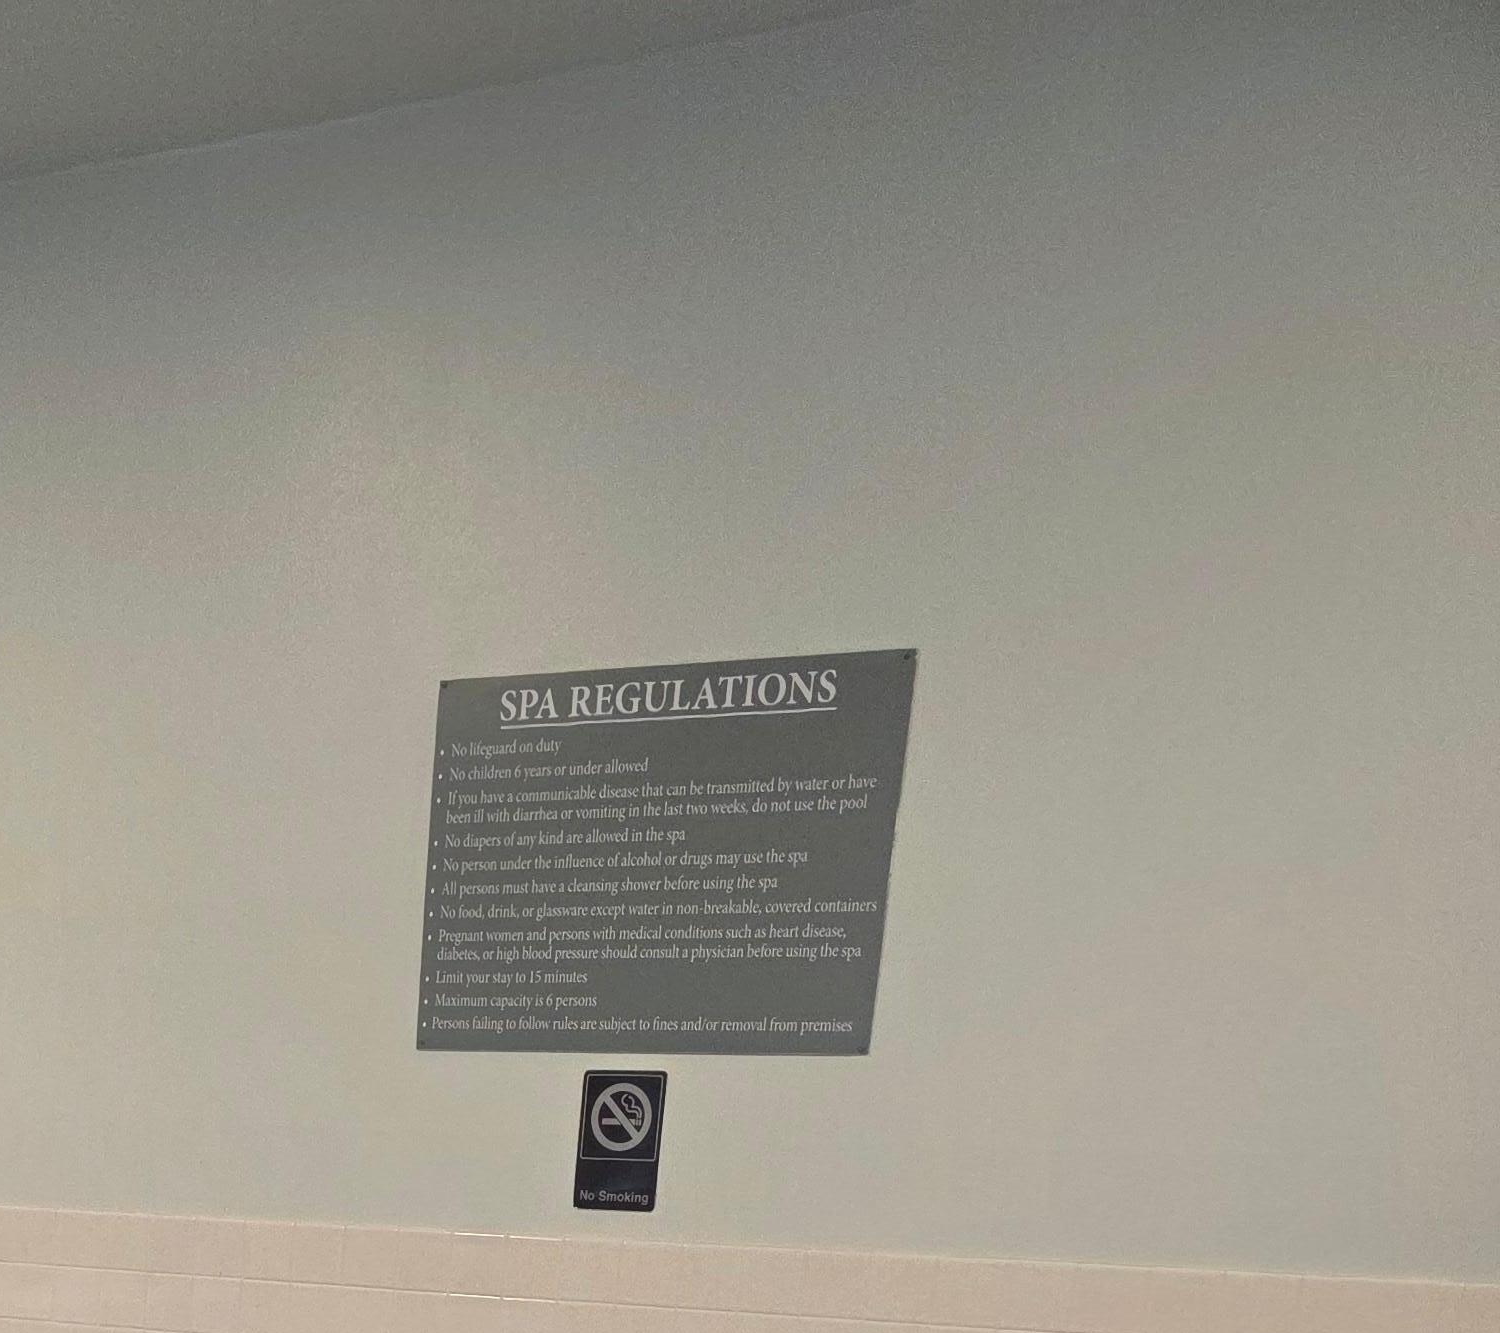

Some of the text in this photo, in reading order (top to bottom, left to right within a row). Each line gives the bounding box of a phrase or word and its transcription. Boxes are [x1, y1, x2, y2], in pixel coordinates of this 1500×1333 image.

[499, 668, 838, 722] SPA REGULATIONS
[451, 737, 562, 760] No lifeguard on duty
[449, 756, 649, 782] No children 6 years or under allowed
[448, 773, 877, 809] If you have a communicable disease that can be transmitted by water or have
[446, 809, 471, 825] been
[473, 808, 485, 823] ill
[487, 807, 510, 823] with
[512, 806, 558, 822] diarrhea
[560, 809, 574, 820] or
[575, 804, 626, 823] vomiting
[628, 803, 640, 818] in
[643, 801, 662, 817] the
[663, 800, 683, 817] last
[686, 803, 708, 815] two
[751, 797, 768, 813] do
[770, 799, 791, 812] not
[794, 800, 815, 812] use
[817, 795, 837, 811] the
[838, 793, 868, 815] pool
[444, 826, 686, 852] No diapers of any kind are allowed in the spa
[443, 848, 808, 876] No person under the influence of alcohol or drugs may use the spa
[442, 873, 778, 900] All persons must have a cleansing shower before using the spa
[440, 904, 456, 919] No
[522, 907, 535, 918] or
[535, 902, 589, 922] glassware
[590, 903, 626, 921] except
[628, 903, 660, 916] water
[661, 901, 673, 915] in
[765, 897, 812, 914] covered
[814, 897, 878, 913] containers
[438, 928, 484, 947] Pregnant
[486, 931, 524, 942] women
[526, 926, 547, 941] and
[548, 930, 591, 945] persons
[592, 925, 616, 941] with
[618, 924, 663, 940] medical
[664, 924, 724, 940] conditions
[725, 923, 752, 939] such
[754, 927, 767, 939] as
[768, 923, 799, 939] heart
[482, 950, 495, 961] or
[496, 945, 520, 965] high
[521, 945, 553, 960] blood
[554, 948, 599, 964] pressure
[600, 944, 638, 959] should
[639, 943, 680, 959] consult
[681, 948, 689, 959] a
[690, 943, 744, 964] physician
[746, 943, 784, 958] before
[785, 943, 818, 962] using
[820, 942, 839, 958] the
[841, 946, 862, 962] spa
[435, 969, 588, 988] Limit your stay to 15 minutes
[434, 993, 597, 1011] Maximum capacity is 6 persons
[431, 1016, 470, 1030] Persons
[472, 1015, 504, 1034] failing
[505, 1018, 517, 1030] to
[518, 1016, 551, 1030] follow
[552, 1016, 579, 1031] rules
[580, 1020, 597, 1030] are
[598, 1016, 637, 1035] subject
[639, 1019, 651, 1031] to
[652, 1016, 679, 1031] fines
[720, 1016, 767, 1032] removal
[769, 1017, 798, 1032] from
[799, 1018, 853, 1036] premises
[579, 1189, 649, 1206] No Smoking
